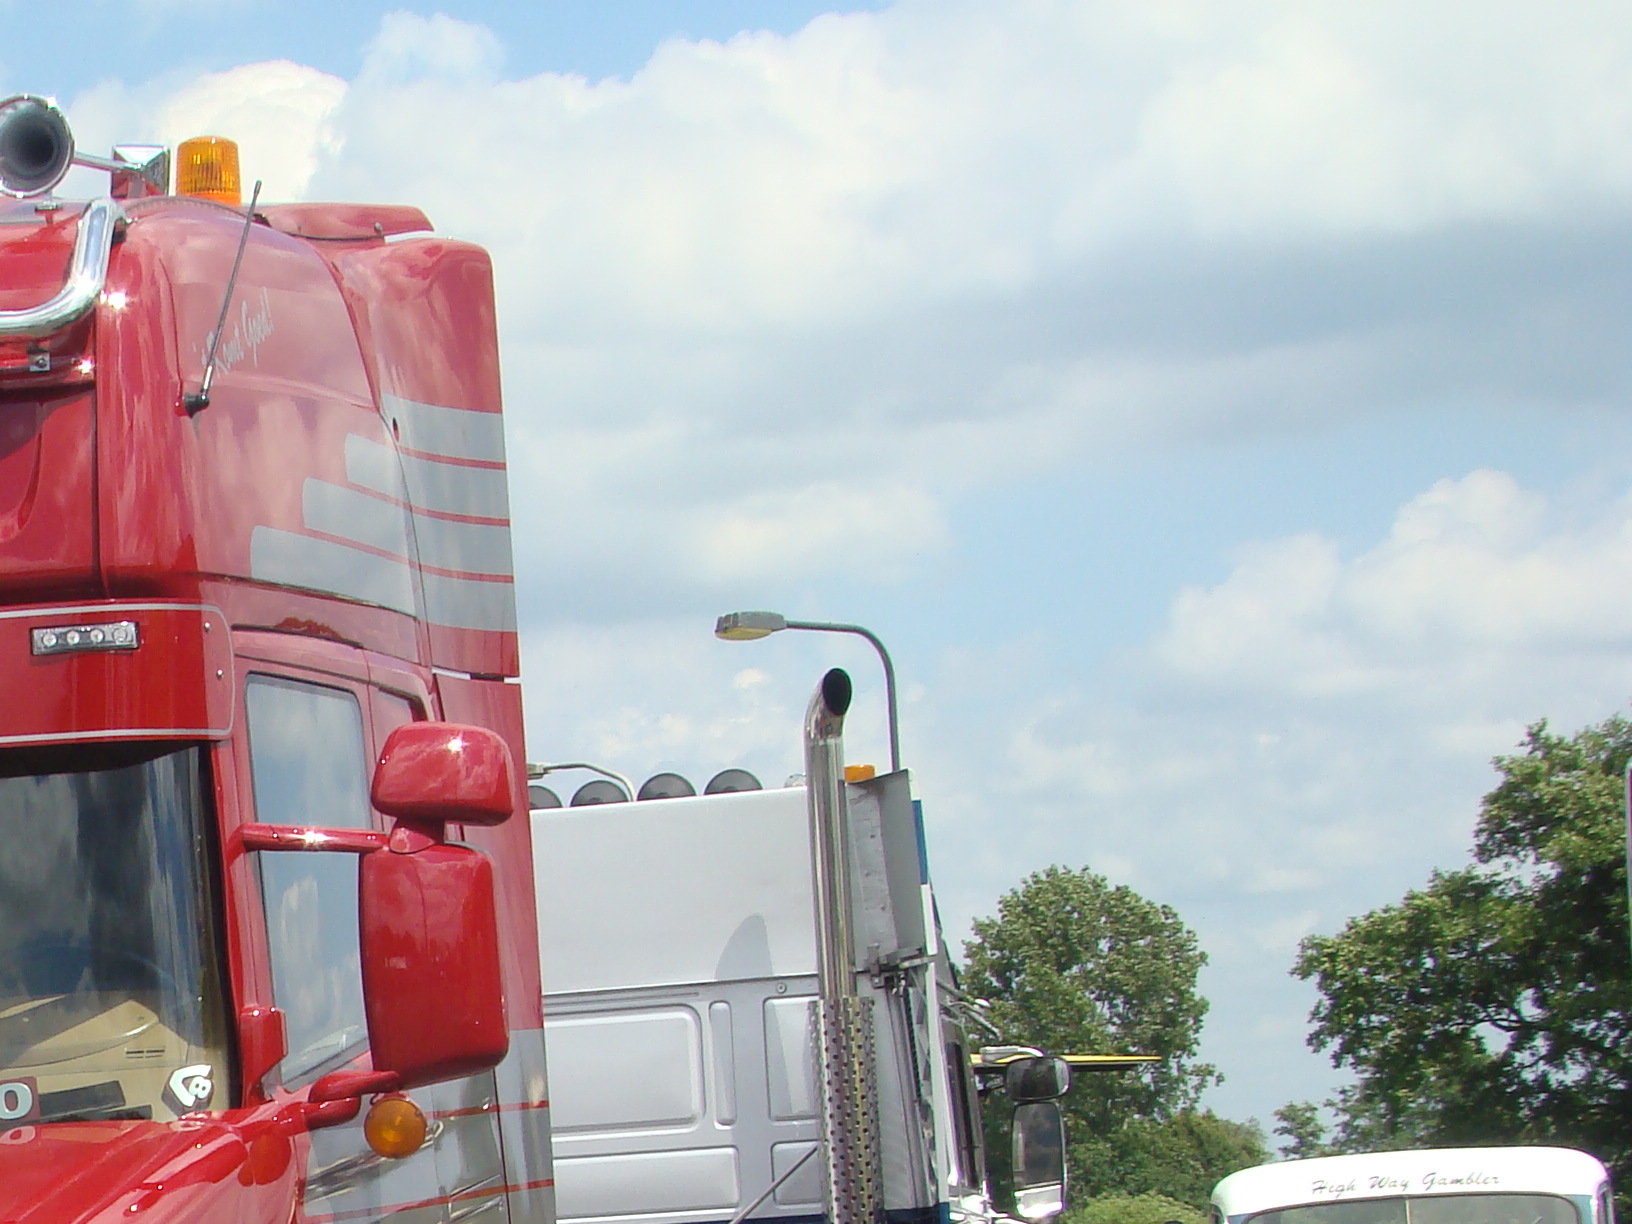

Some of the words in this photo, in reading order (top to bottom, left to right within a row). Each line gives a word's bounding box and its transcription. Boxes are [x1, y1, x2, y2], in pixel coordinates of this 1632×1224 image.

[1311, 1178, 1357, 1199] High
[1369, 1175, 1410, 1191] Way
[1421, 1172, 1501, 1191] Gambler
